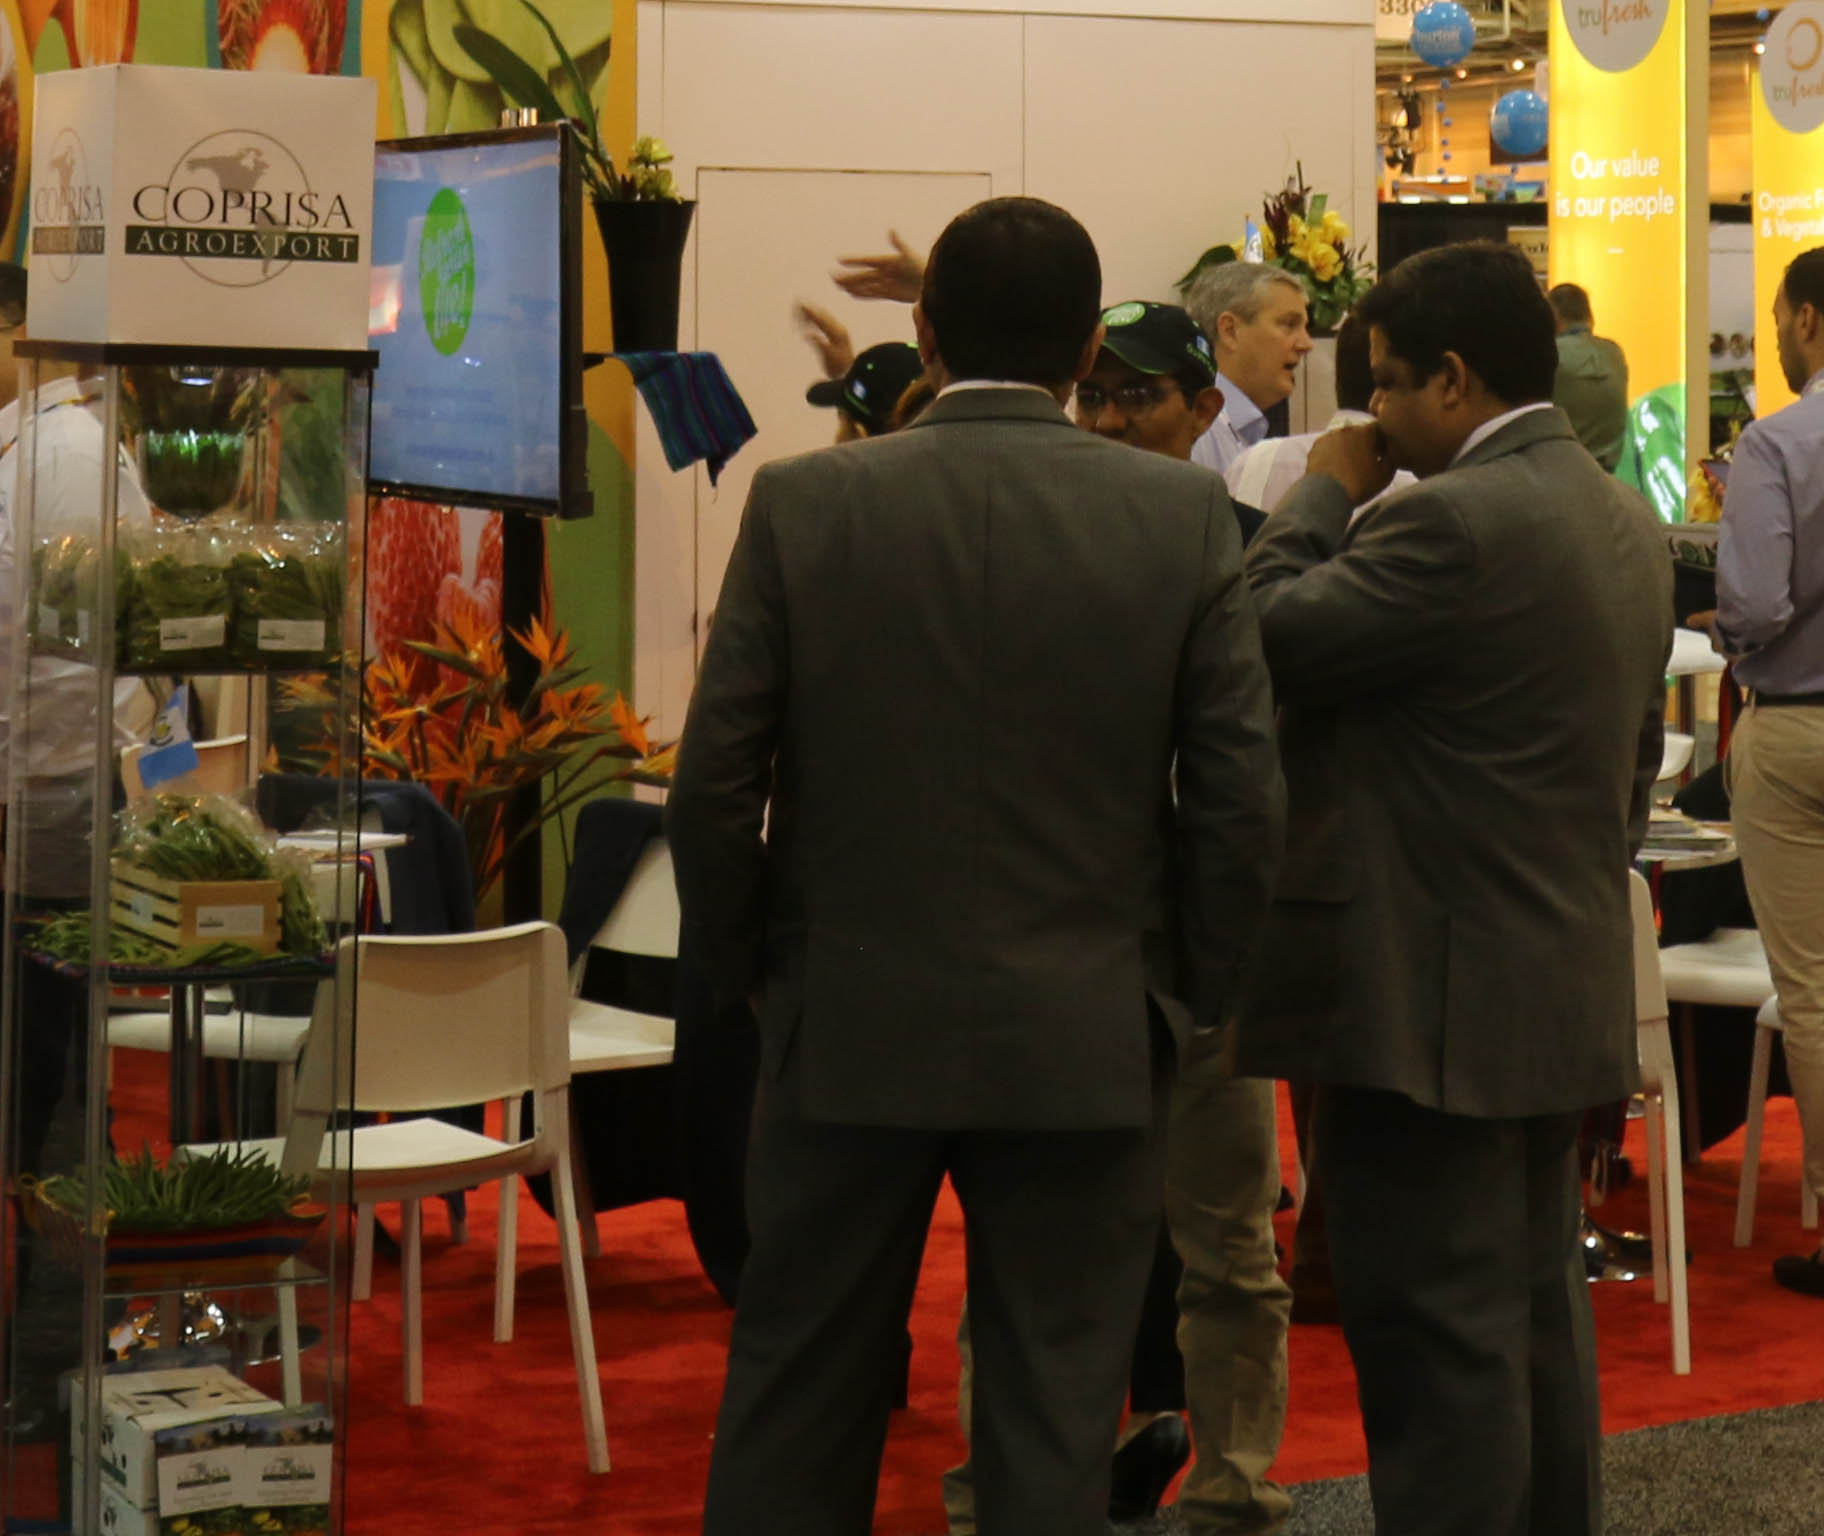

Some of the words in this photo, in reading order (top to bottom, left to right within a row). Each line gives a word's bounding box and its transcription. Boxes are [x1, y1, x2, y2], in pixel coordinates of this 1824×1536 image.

[1570, 151, 1608, 180] Our
[1612, 149, 1661, 178] value
[133, 184, 354, 229] COPRISA
[1555, 192, 1571, 218] is
[1574, 196, 1607, 217] our
[1610, 187, 1675, 223] people
[1759, 191, 1813, 217] Organic
[136, 232, 355, 260] AGROEXPORT
